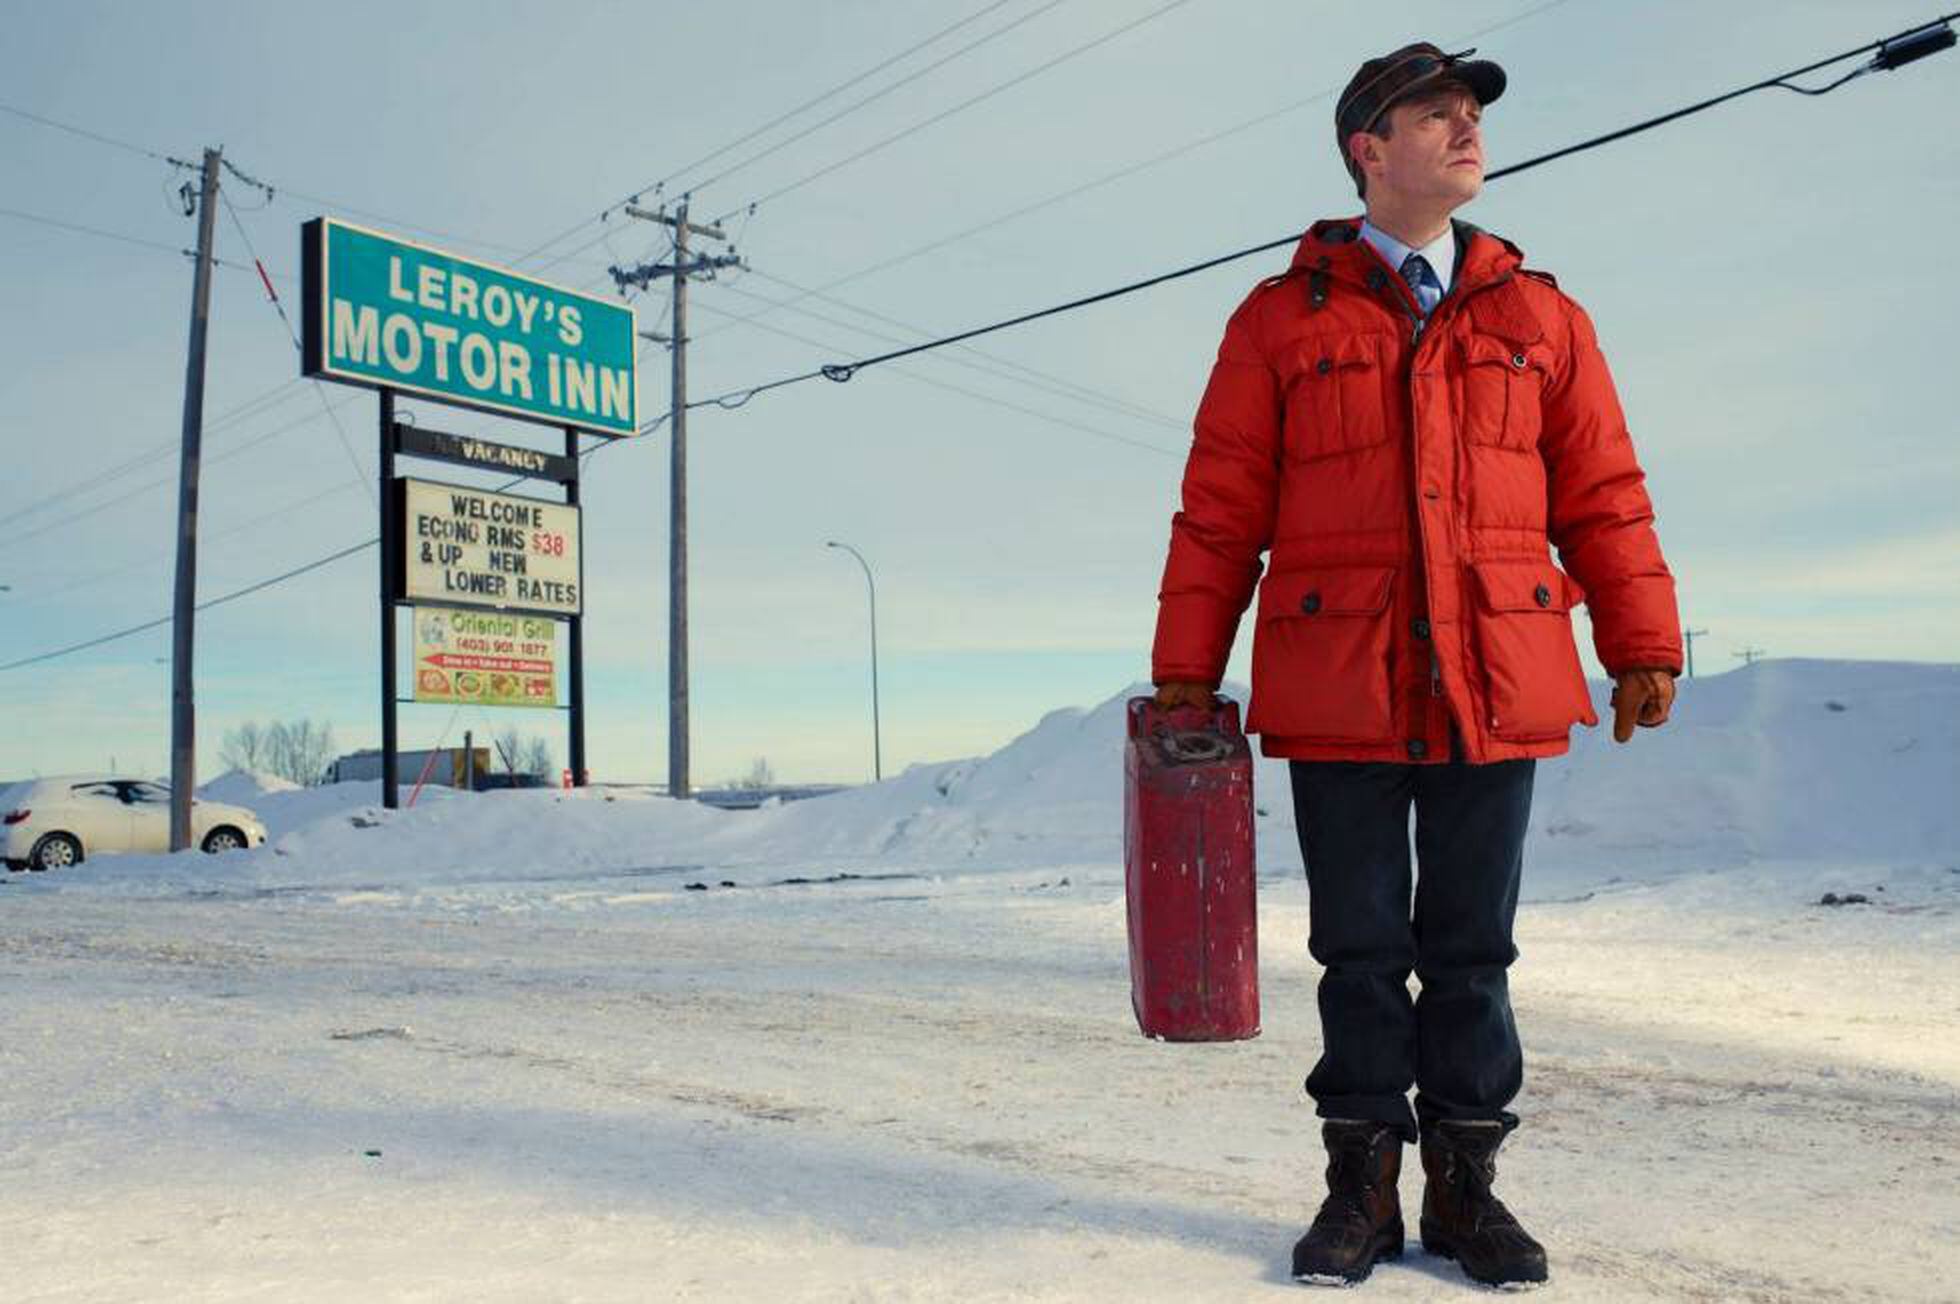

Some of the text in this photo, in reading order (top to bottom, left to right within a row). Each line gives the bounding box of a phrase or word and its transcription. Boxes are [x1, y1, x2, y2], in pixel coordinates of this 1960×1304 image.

[389, 255, 583, 346] LEROY'S
[333, 298, 629, 421] MOTOR INN
[462, 440, 546, 472] VACANCY
[451, 495, 543, 528] WELCOME
[487, 526, 525, 550] RMS
[532, 533, 563, 556] $38
[439, 544, 463, 566] UP
[489, 551, 527, 575] NEW
[446, 570, 577, 604] LOWER RATES
[451, 612, 517, 638] Oriental
